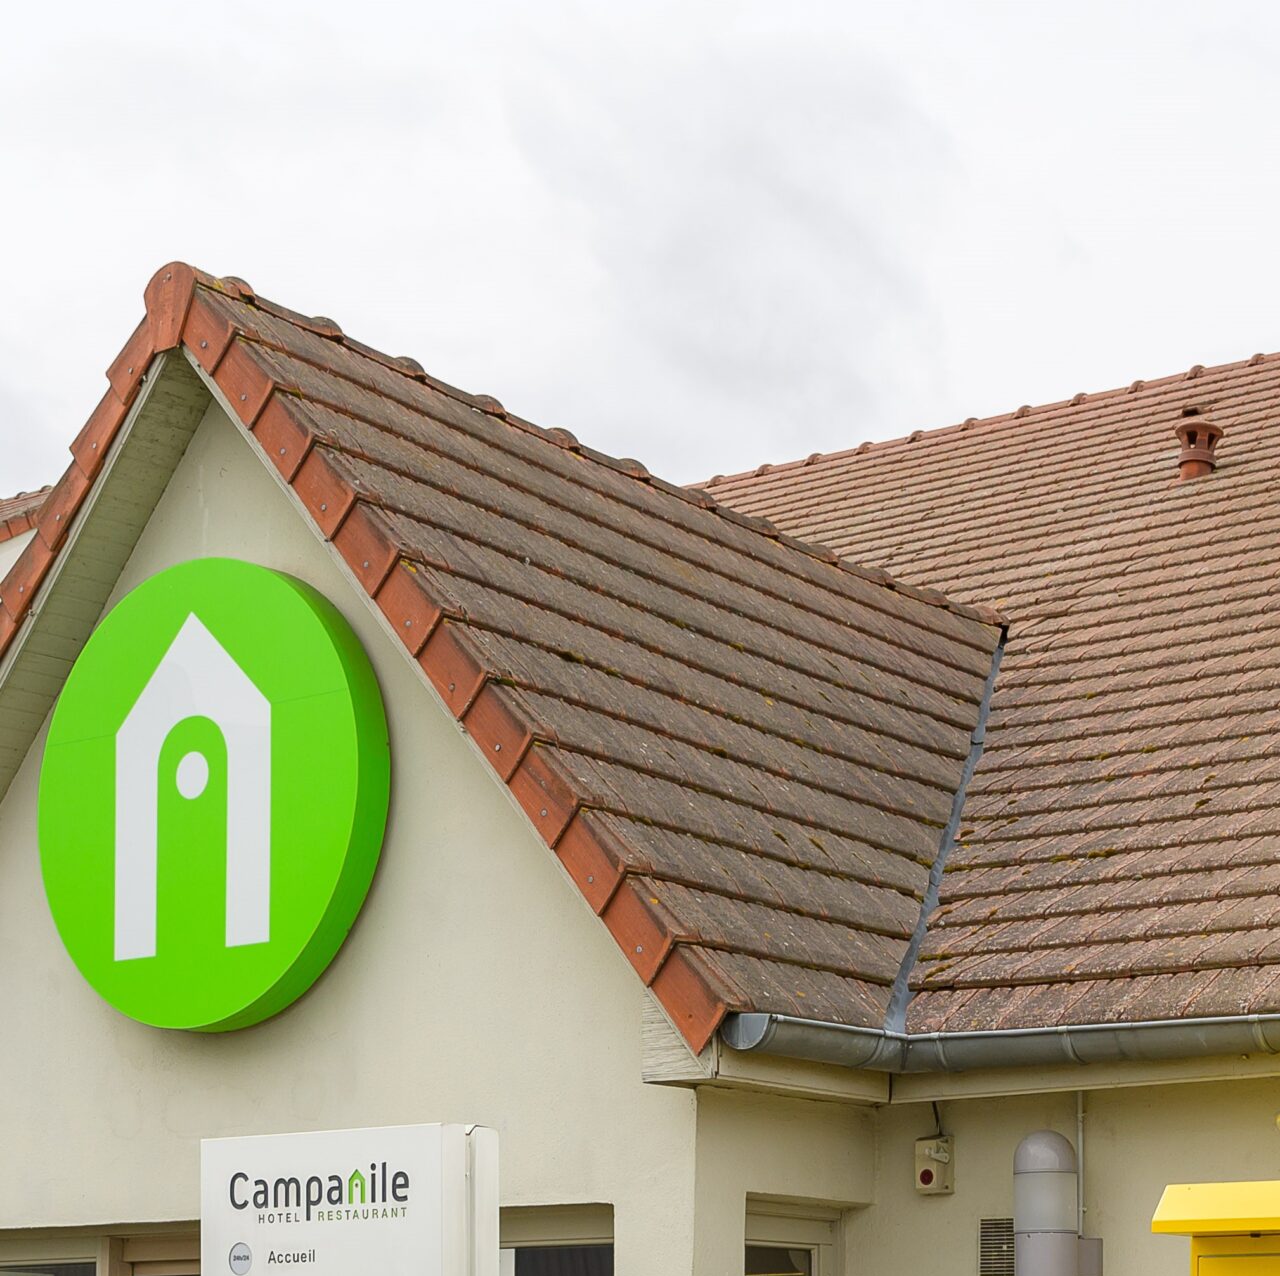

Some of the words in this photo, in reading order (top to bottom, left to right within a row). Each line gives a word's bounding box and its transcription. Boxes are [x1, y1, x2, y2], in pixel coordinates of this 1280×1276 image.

[229, 1162, 410, 1222] Campanile
[258, 1212, 300, 1224] HOTEL
[318, 1207, 407, 1221] RESTAURANT
[268, 1249, 315, 1264] Accueil
